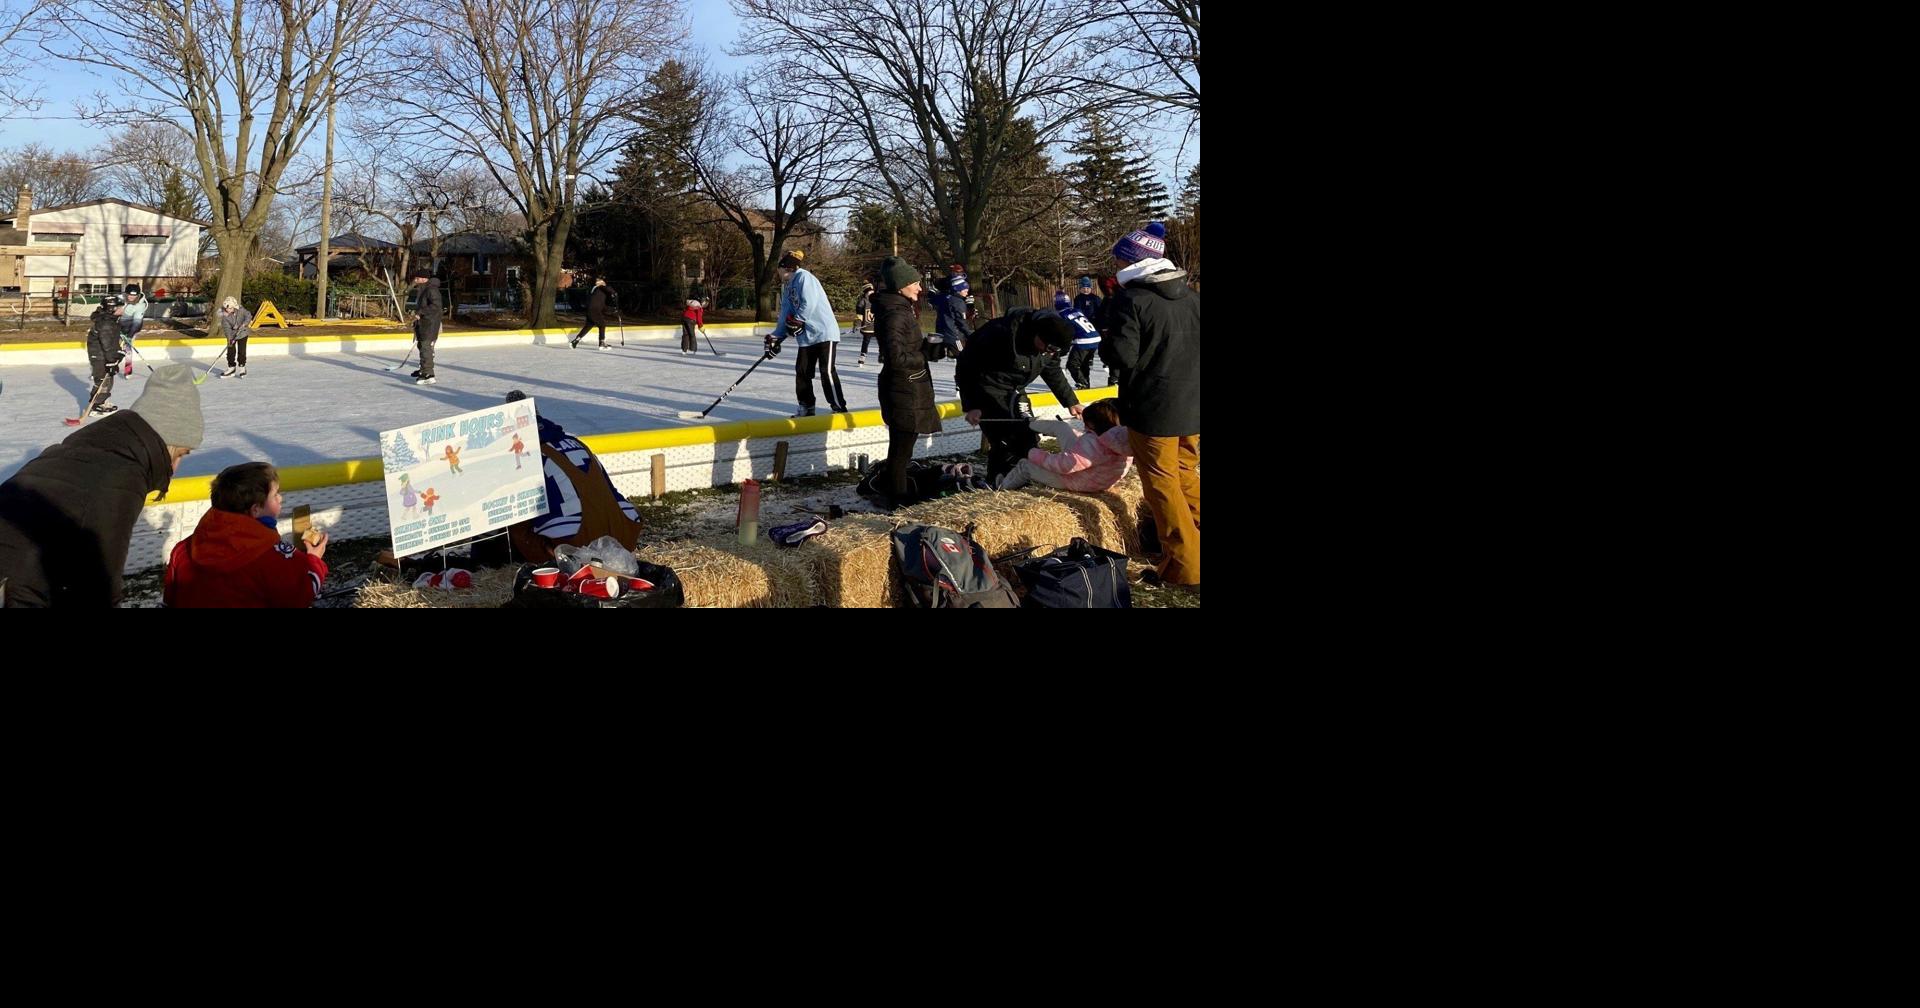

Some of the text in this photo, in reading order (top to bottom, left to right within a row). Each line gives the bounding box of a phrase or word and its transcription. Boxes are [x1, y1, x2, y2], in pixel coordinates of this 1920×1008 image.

[1074, 316, 1096, 333] 16
[421, 411, 505, 445] RINK HOURS
